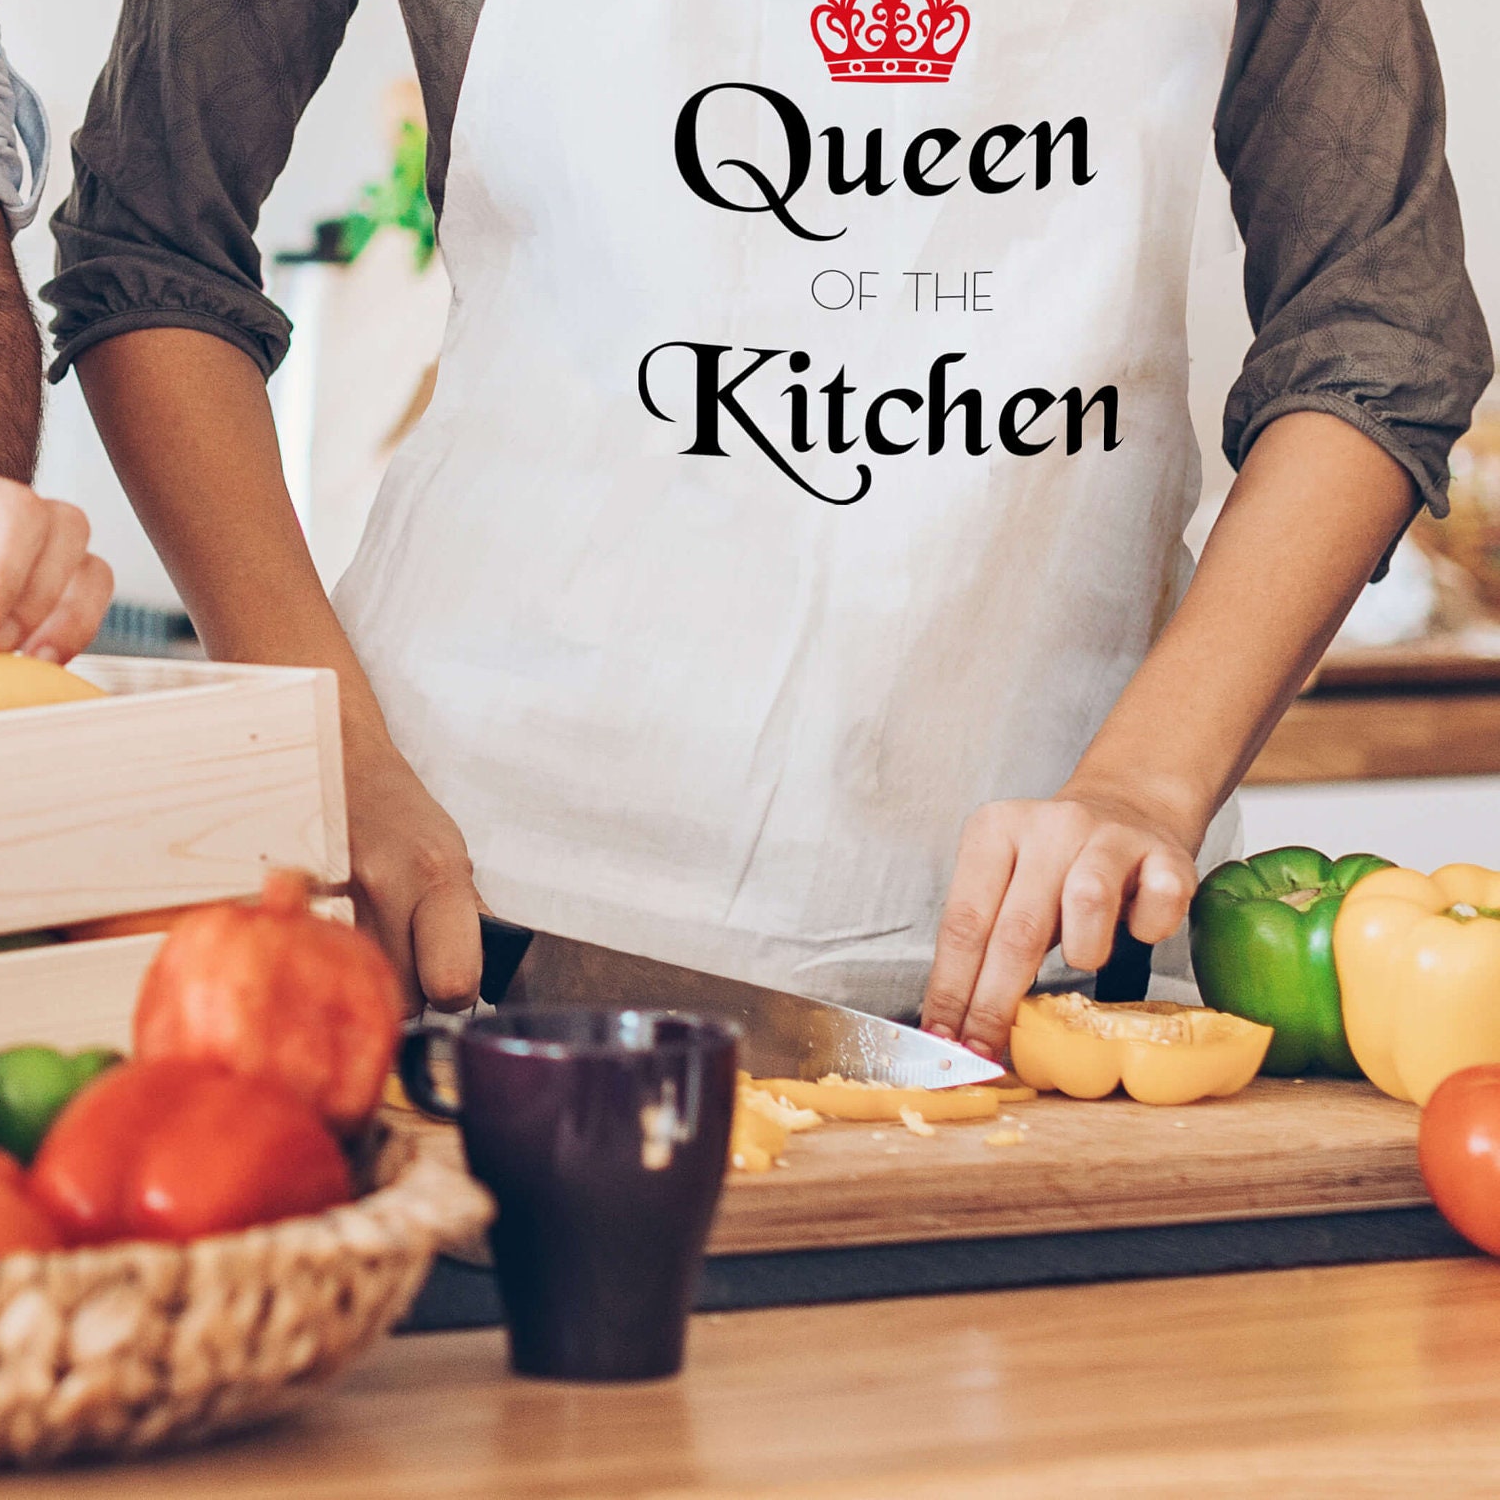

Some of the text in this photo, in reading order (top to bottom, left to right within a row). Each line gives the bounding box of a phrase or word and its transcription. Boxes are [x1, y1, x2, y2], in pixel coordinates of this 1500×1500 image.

[674, 82, 1098, 242] Queen
[811, 269, 994, 312] OF THE
[638, 341, 1125, 506] Kitchen
